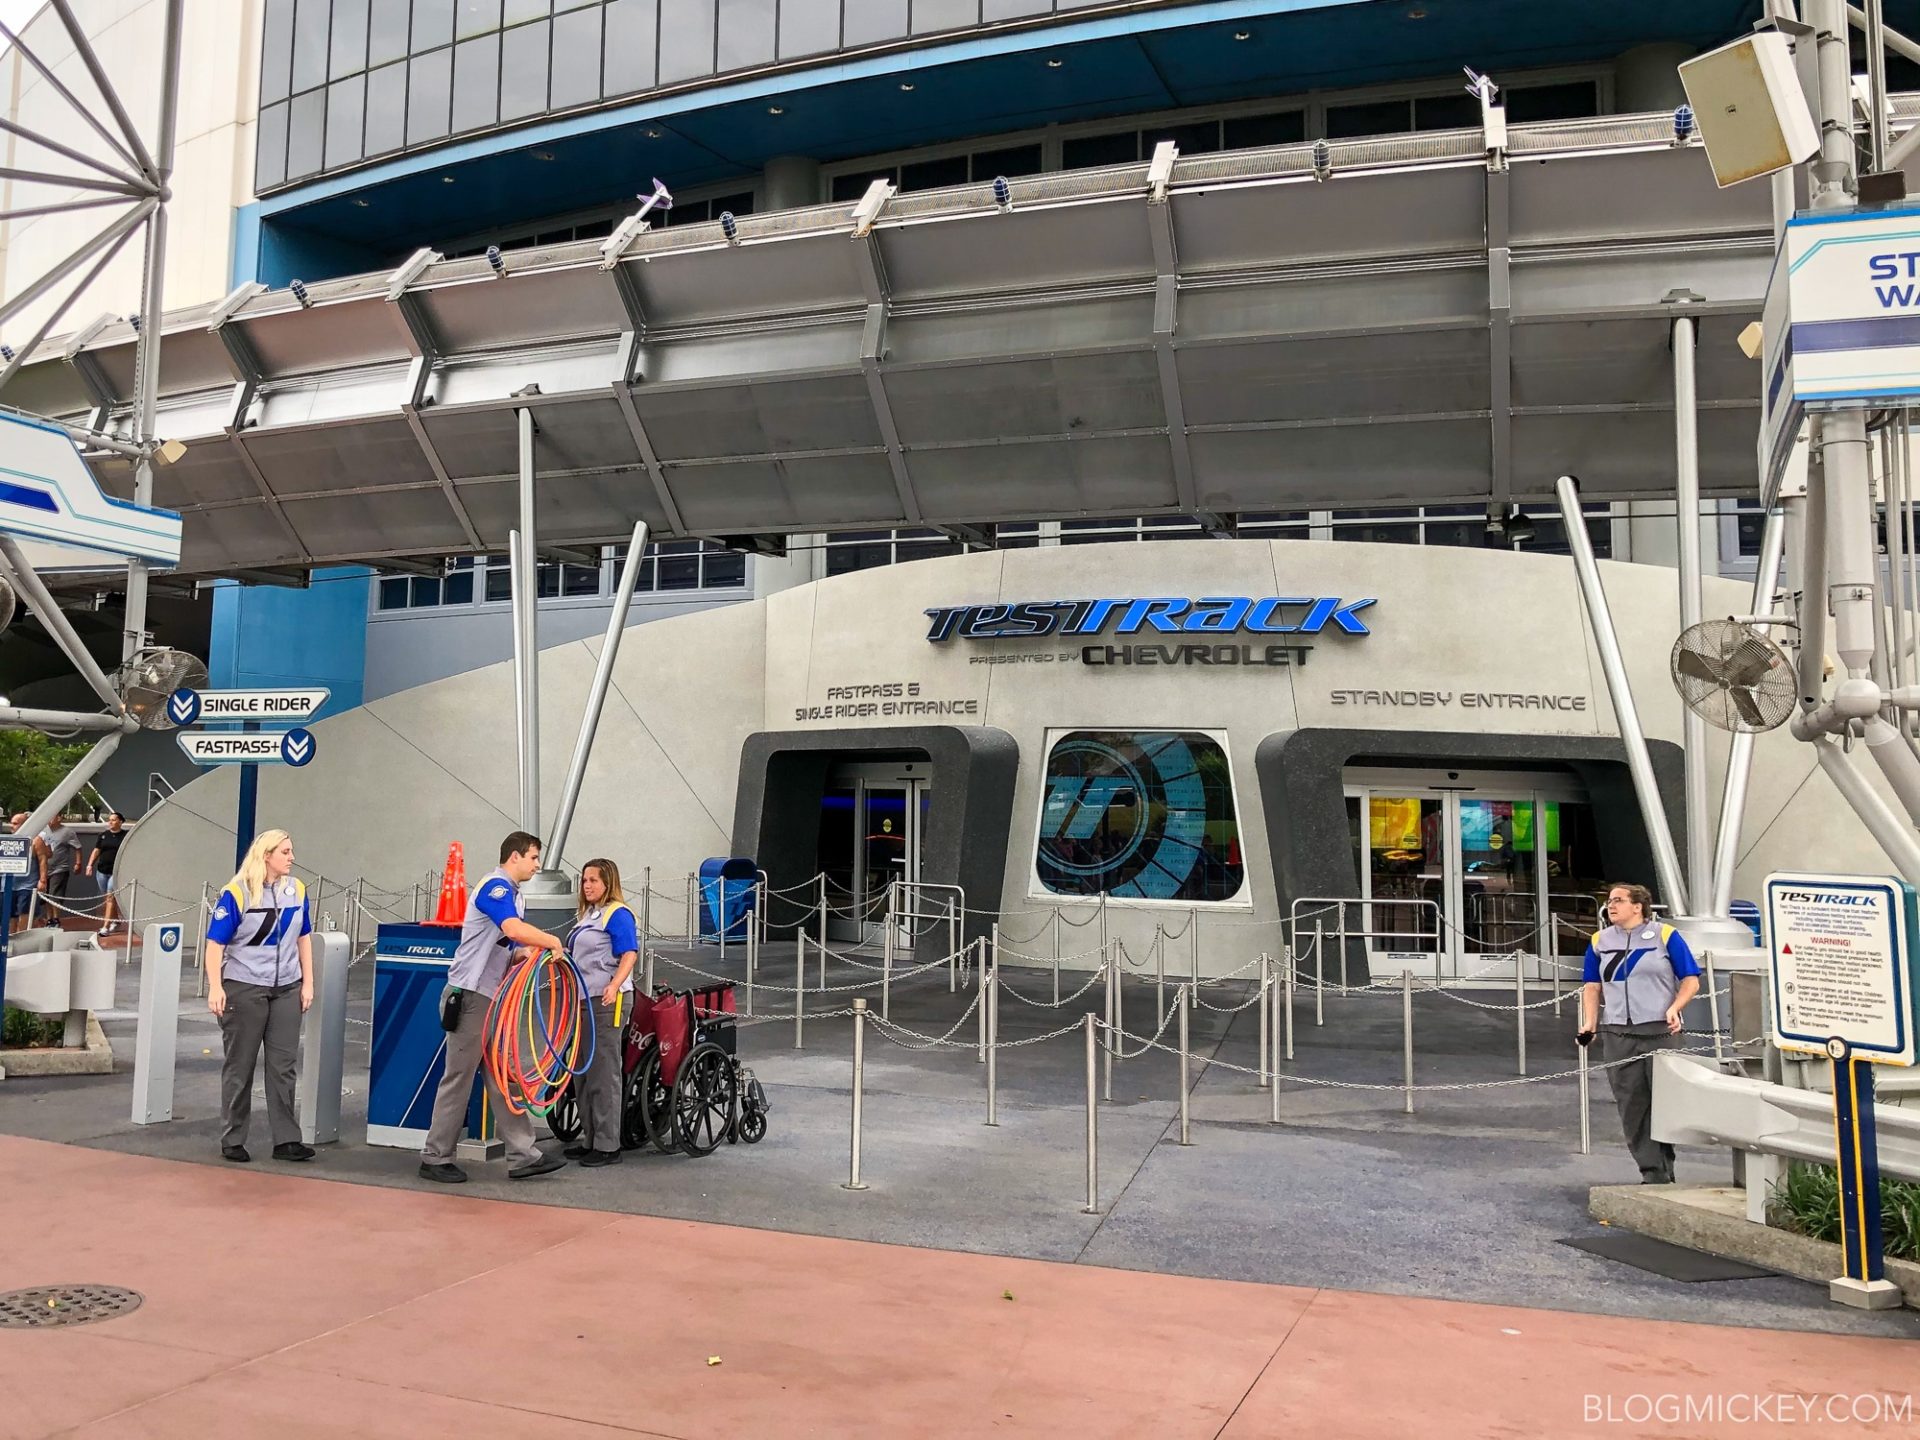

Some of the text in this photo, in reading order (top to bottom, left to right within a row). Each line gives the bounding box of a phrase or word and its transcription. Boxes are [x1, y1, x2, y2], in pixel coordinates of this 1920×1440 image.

[1869, 252, 1920, 281] ST
[969, 644, 1314, 667] PRESENTED BY CHEVROLET
[827, 682, 920, 701] FASTPASS &
[1330, 690, 1587, 711] STANDBY ENTRANCE
[204, 697, 311, 712] SINGLE RIDER
[795, 699, 977, 721] SINGLE RIDER ENTRANCE
[195, 740, 280, 754] FASTPASS+
[1810, 937, 1851, 947] WARNING!
